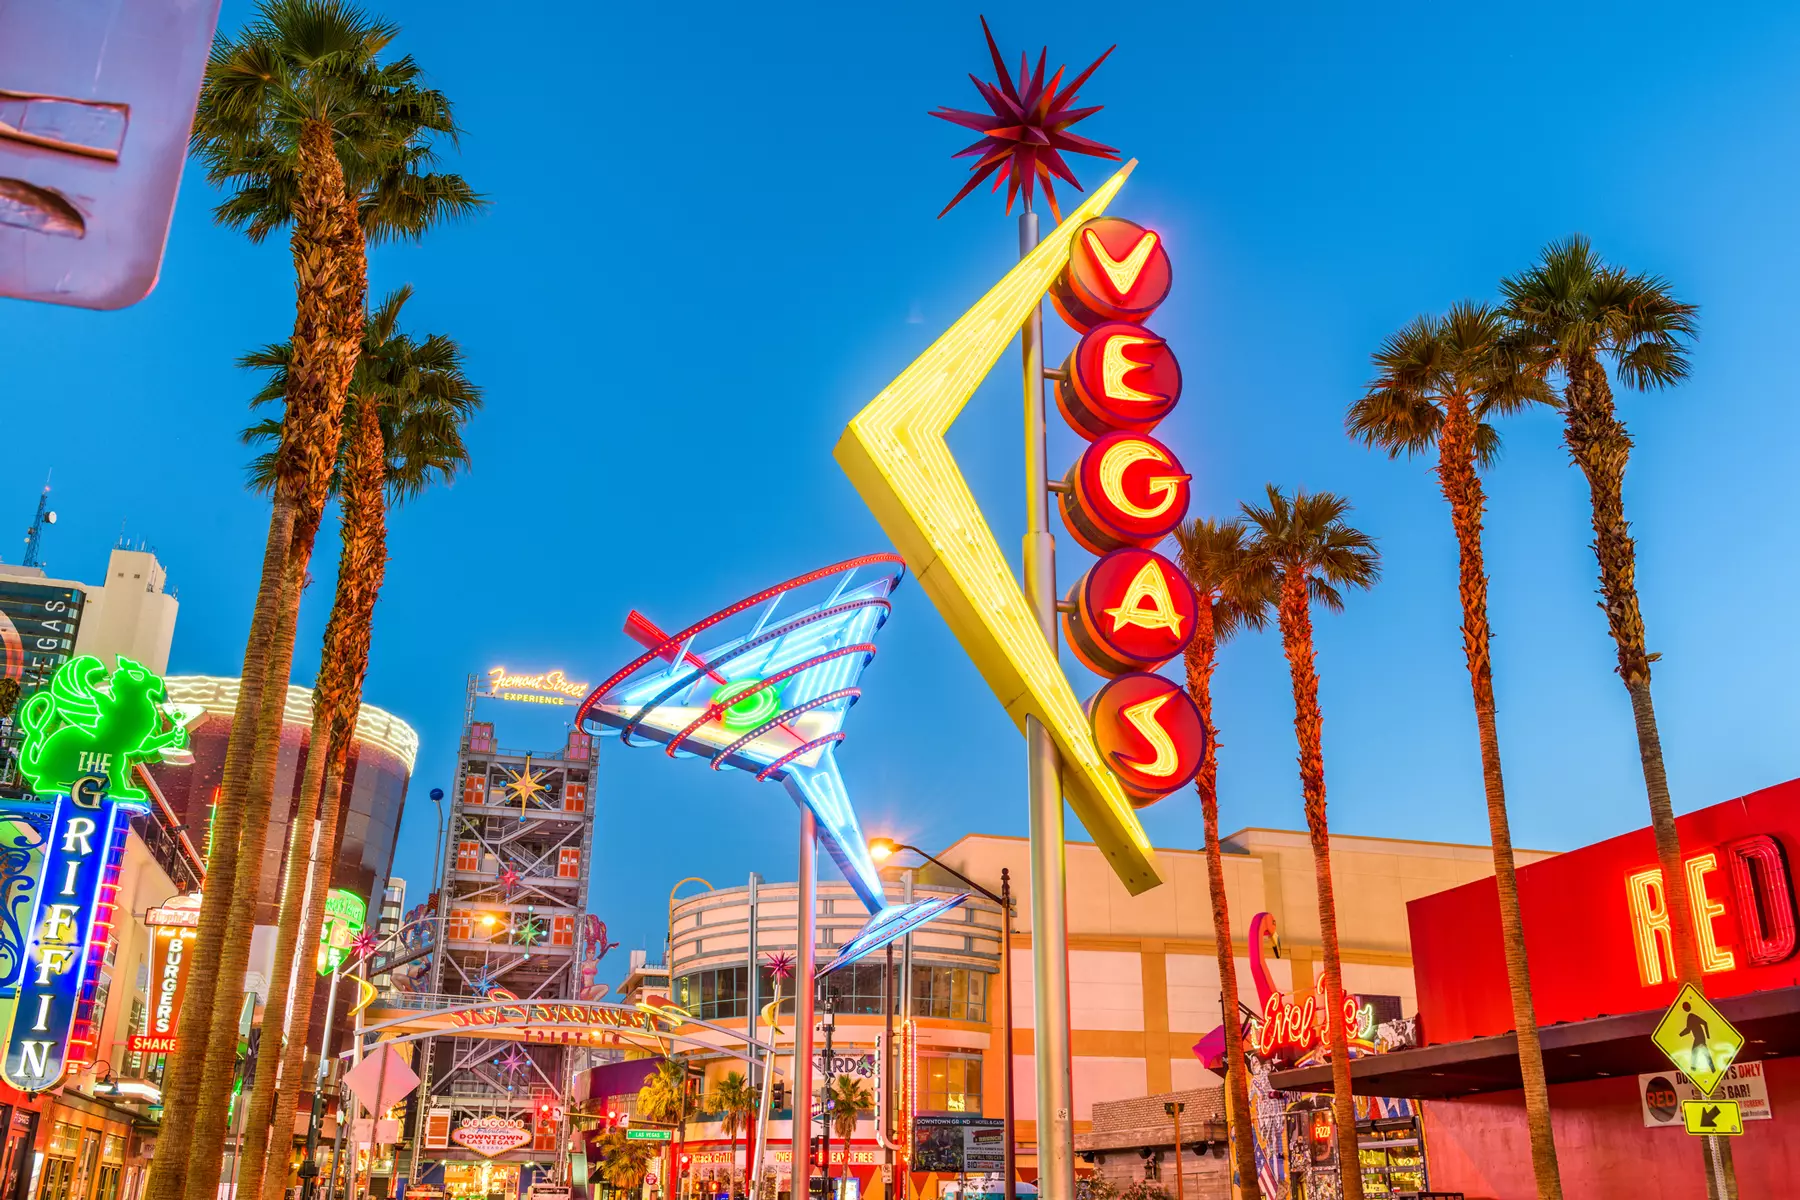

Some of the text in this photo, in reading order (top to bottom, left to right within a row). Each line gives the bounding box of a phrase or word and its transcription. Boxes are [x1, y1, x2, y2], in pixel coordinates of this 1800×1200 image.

[1081, 228, 1193, 777] VEGAS
[28, 600, 66, 687] VEGAS
[488, 667, 588, 698] Fremont Street
[504, 693, 565, 705] EXPERIENCE
[78, 751, 112, 773] THE
[1625, 834, 1798, 987] RED
[17, 776, 108, 1081] GRIFFIN
[156, 939, 184, 1033] BURGERS
[1261, 992, 1315, 1055] Evel
[812, 1057, 857, 1075] NRD
[1739, 1063, 1762, 1079] ONLY
[1647, 1089, 1676, 1109] RED
[1727, 1084, 1751, 1100] BAR!
[462, 1119, 523, 1128] WELCOME
[1315, 1126, 1331, 1139] PIZZA
[714, 1152, 731, 1163] Grill
[853, 1152, 874, 1163] FREE
